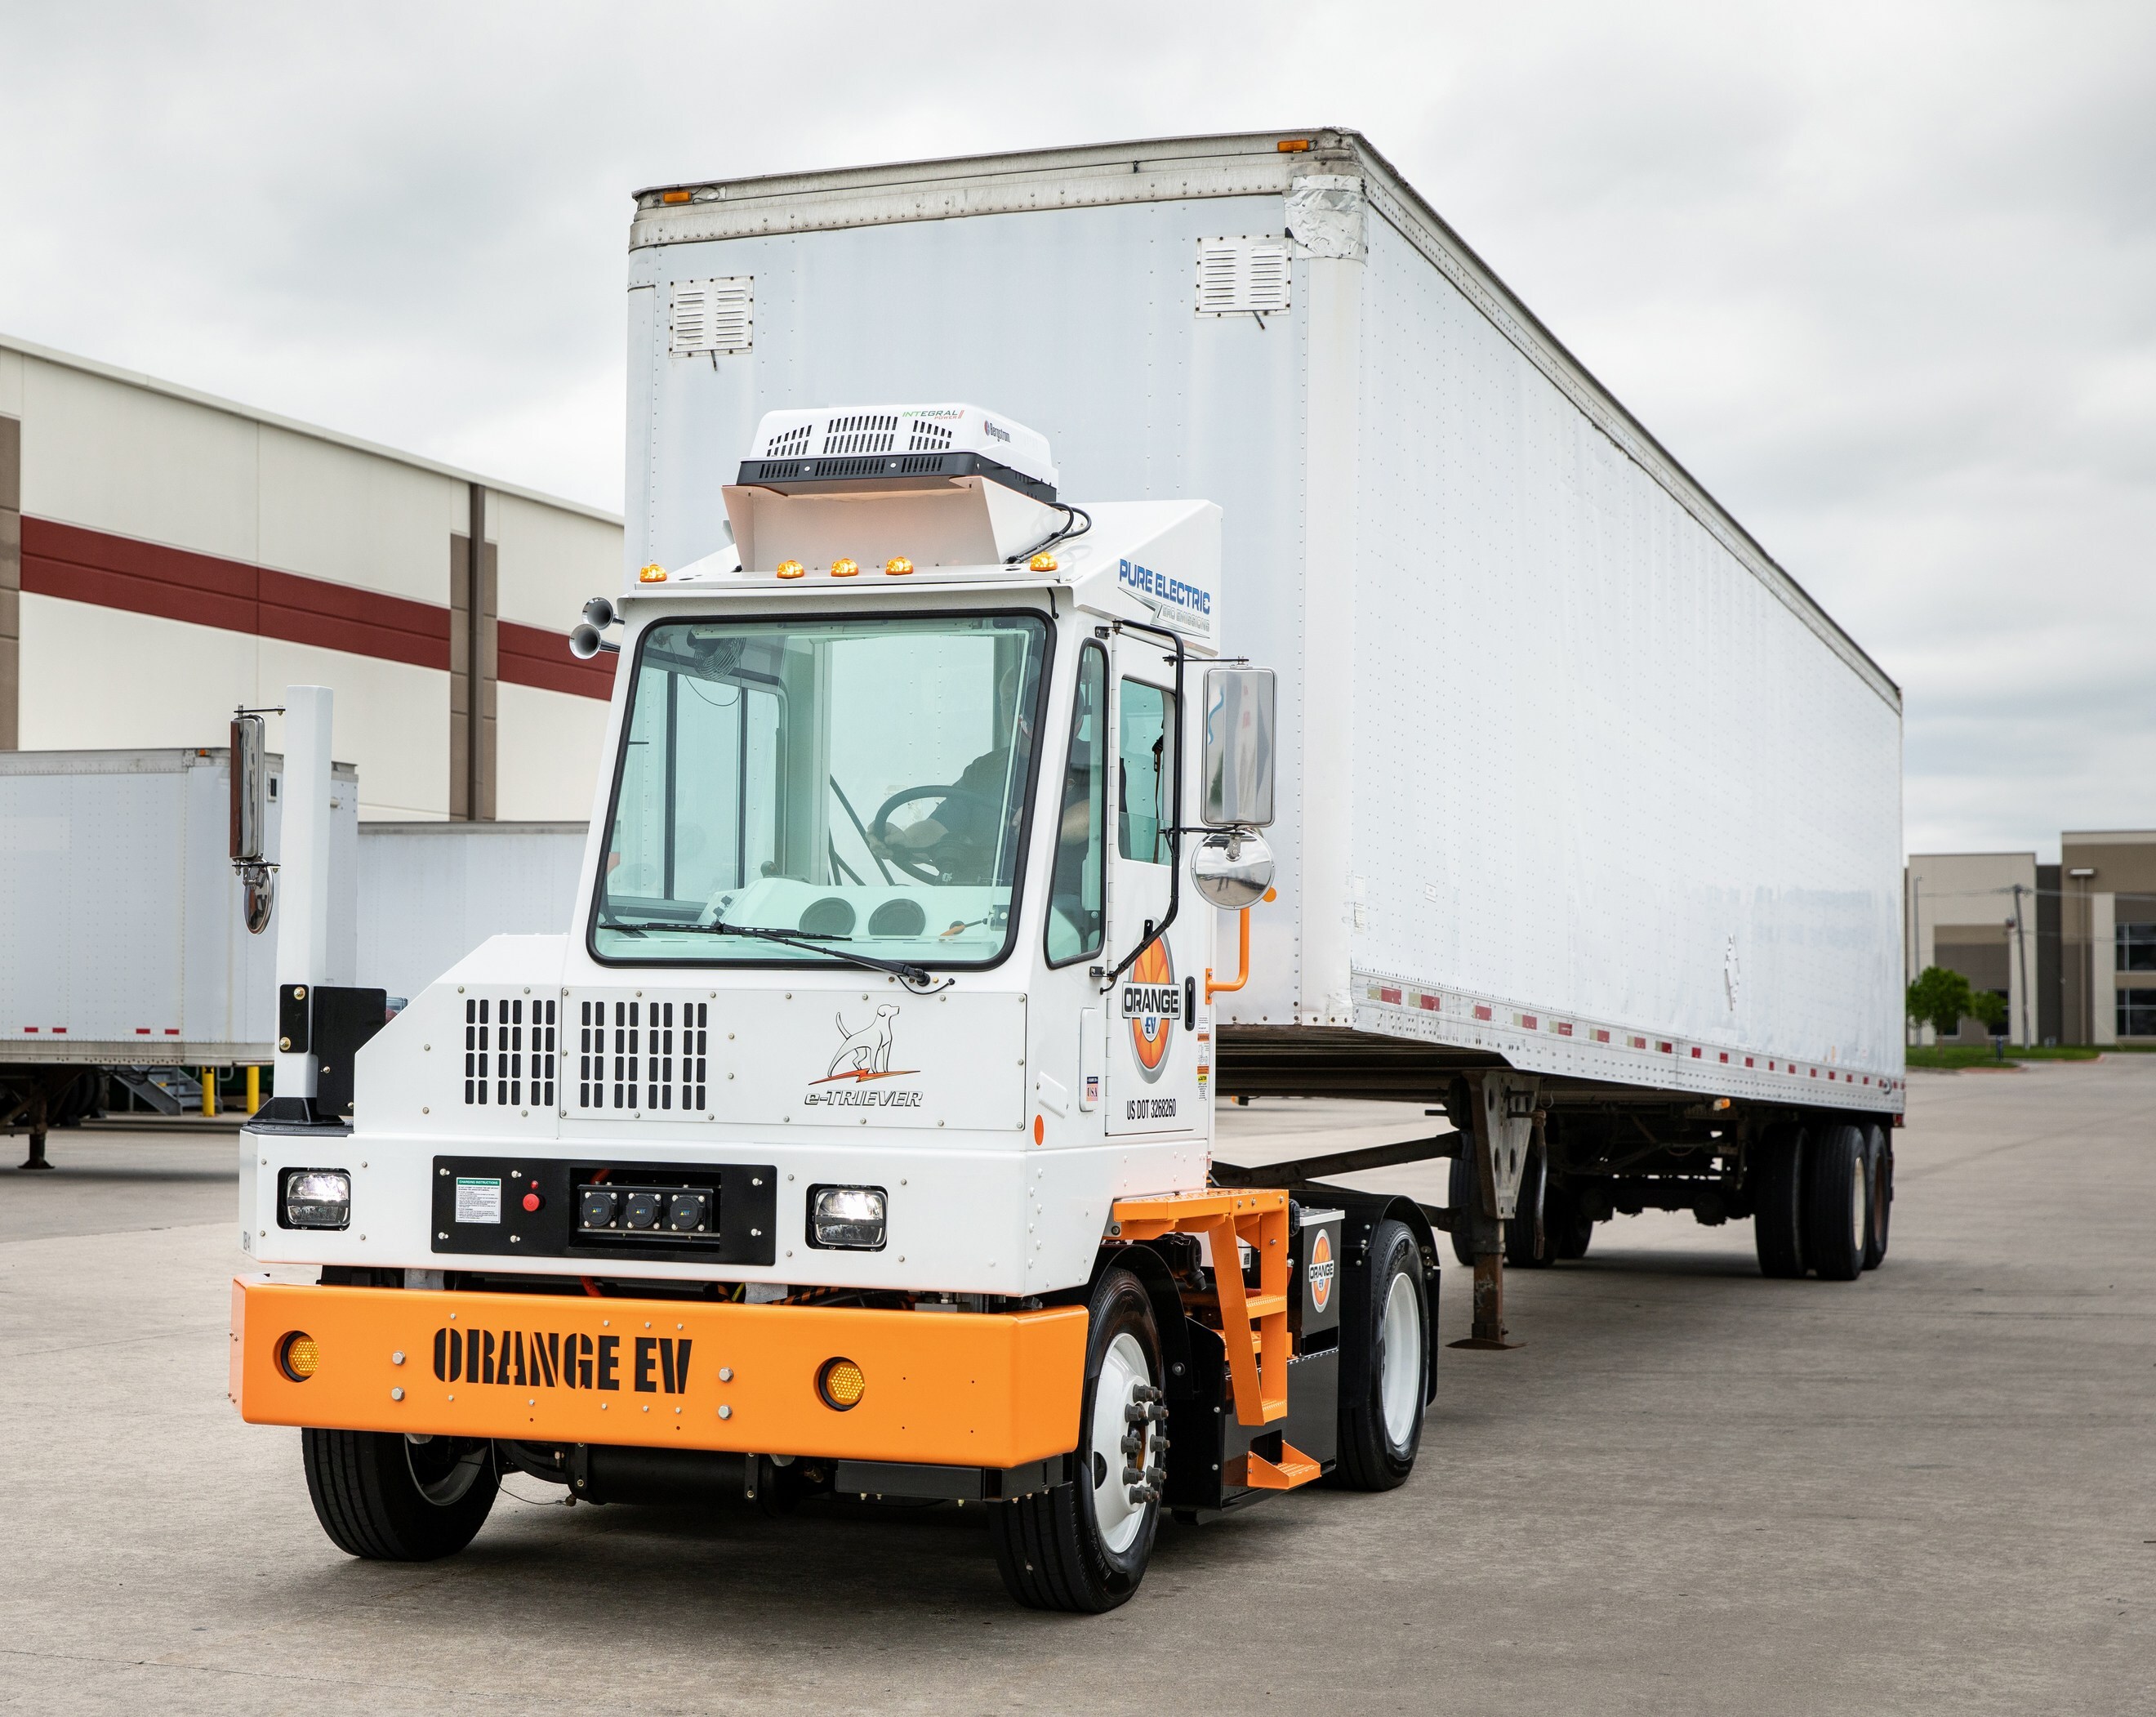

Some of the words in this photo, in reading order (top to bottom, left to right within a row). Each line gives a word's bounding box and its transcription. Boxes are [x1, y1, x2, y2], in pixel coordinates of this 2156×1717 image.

[989, 422, 1011, 443] Bergstrom
[1120, 559, 1152, 593] PURE
[1156, 573, 1209, 614] ELECTRIC
[1176, 609, 1210, 632] EMISSIONS
[1124, 987, 1179, 1014] ORANGE
[1145, 1016, 1156, 1035] EV
[804, 1090, 924, 1108] e-TRIEVER
[1127, 1100, 1135, 1120] US
[1137, 1099, 1150, 1119] DOT
[1151, 1099, 1176, 1118] 3268260
[1310, 1263, 1334, 1278] ORANGE
[433, 1327, 621, 1392] ORANGE
[634, 1336, 693, 1394] EV
